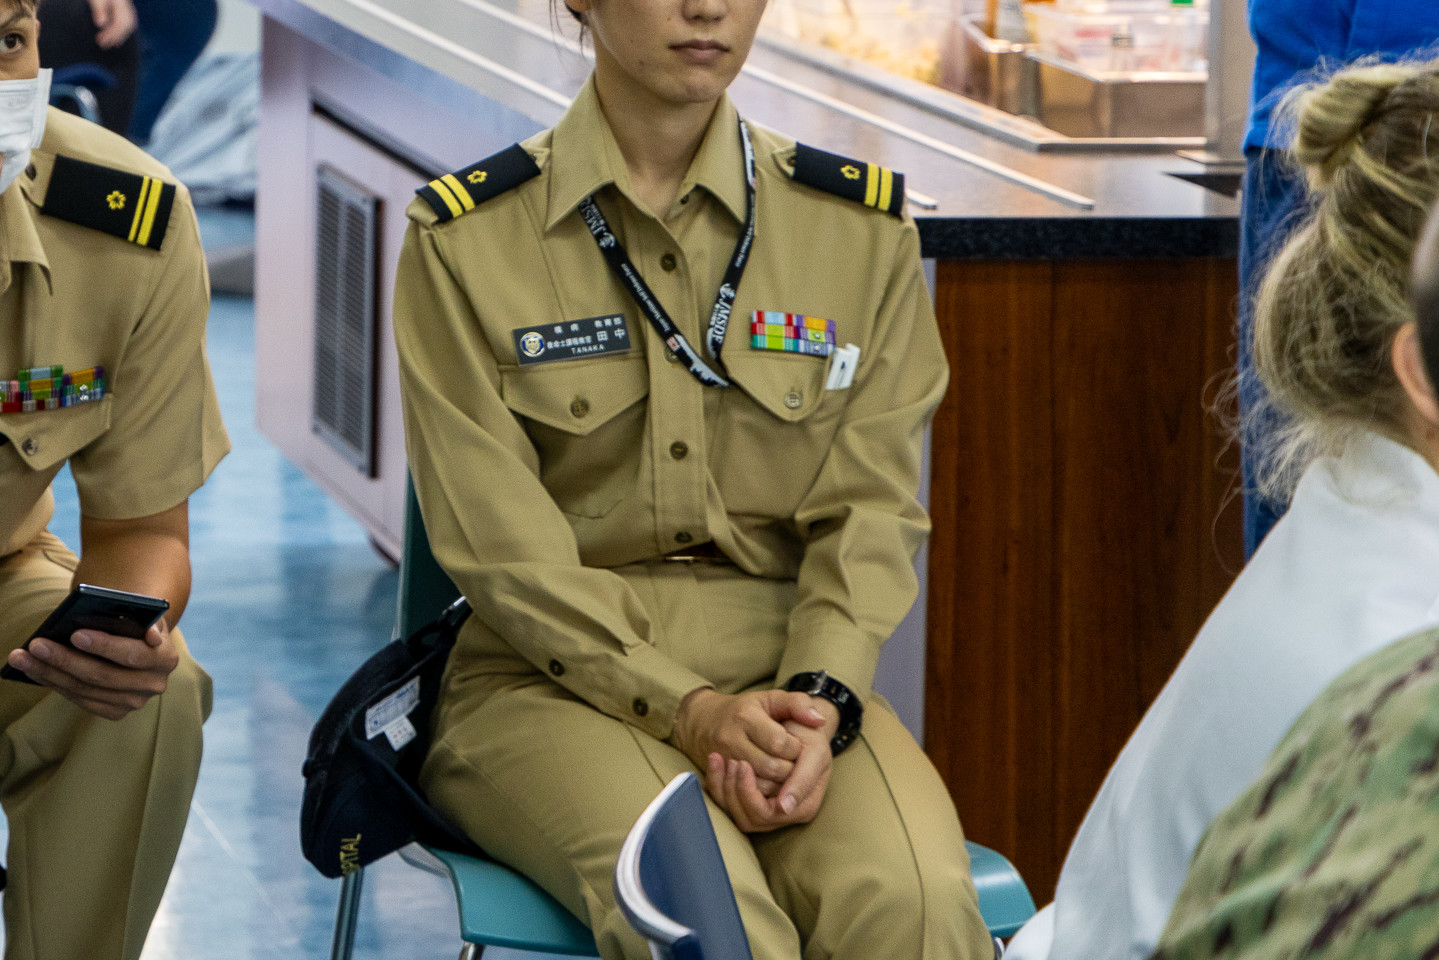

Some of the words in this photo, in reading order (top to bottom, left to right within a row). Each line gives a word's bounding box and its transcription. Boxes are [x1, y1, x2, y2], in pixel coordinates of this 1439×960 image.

[712, 298, 732, 345] JMSDF
[596, 327, 626, 342] 田中
[571, 343, 606, 355] TANAKA
